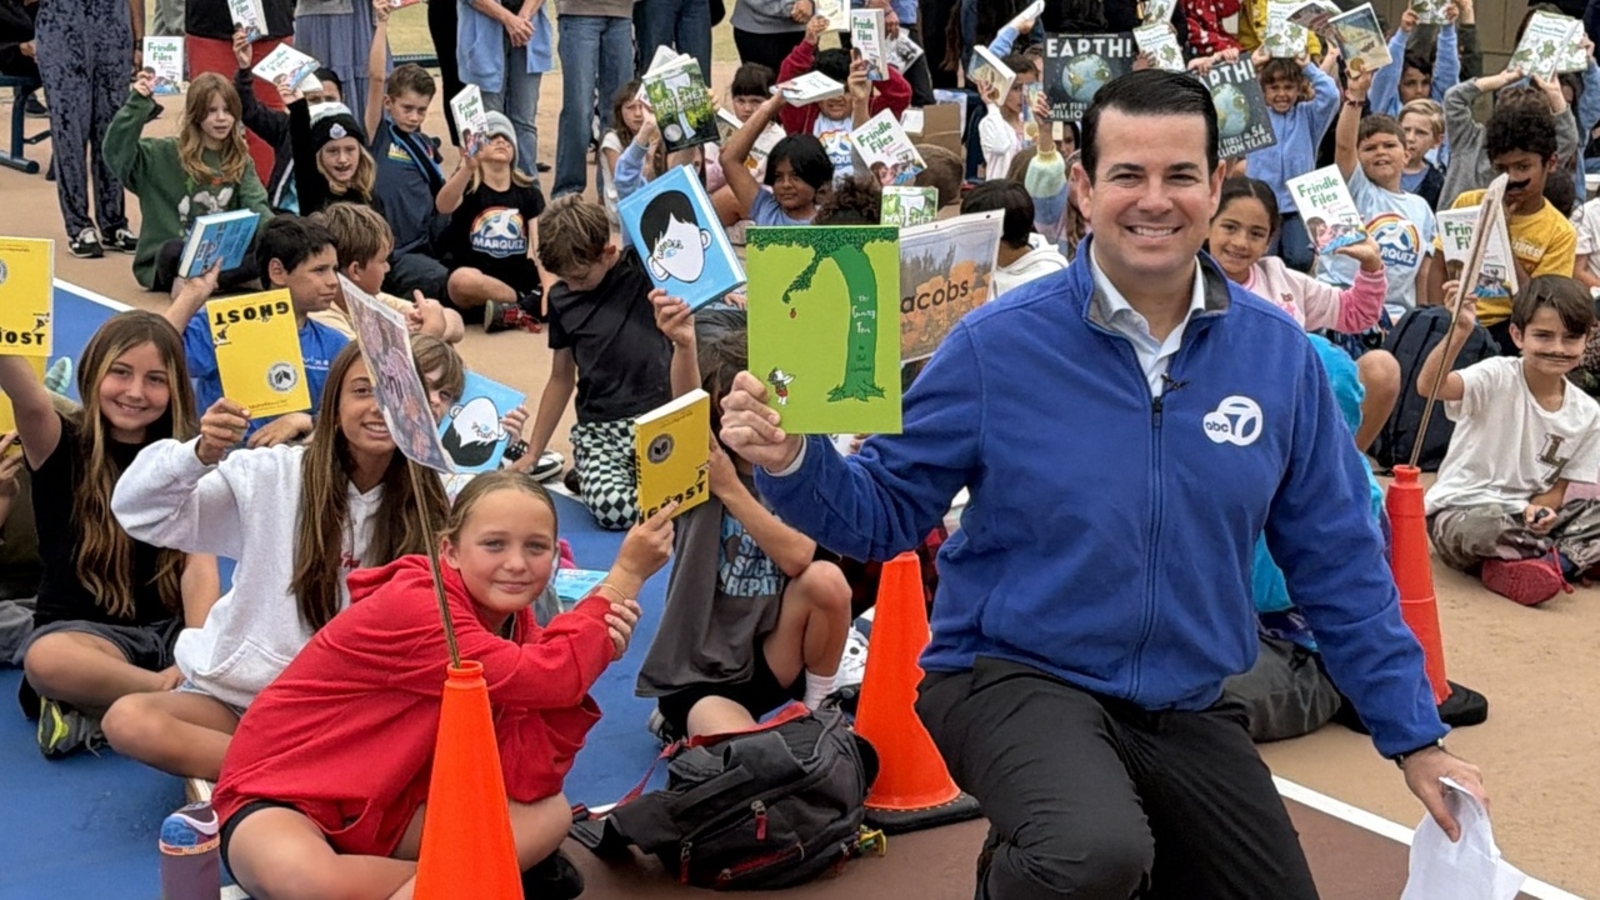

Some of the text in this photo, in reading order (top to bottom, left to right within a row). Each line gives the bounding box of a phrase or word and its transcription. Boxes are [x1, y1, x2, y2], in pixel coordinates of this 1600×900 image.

[857, 30, 873, 41] Files
[147, 41, 178, 52] Frindle
[1046, 38, 1132, 58] EARTH!
[856, 120, 893, 148] Frindle
[869, 134, 894, 155] Files
[1297, 175, 1339, 198] Frindle
[1310, 191, 1339, 208] Files
[1444, 221, 1473, 237] Frin
[472, 236, 526, 250] MARQUEZ
[900, 280, 969, 315] acobs
[214, 301, 290, 326] GHOST
[0, 331, 45, 346] OST
[1205, 420, 1230, 434] abc
